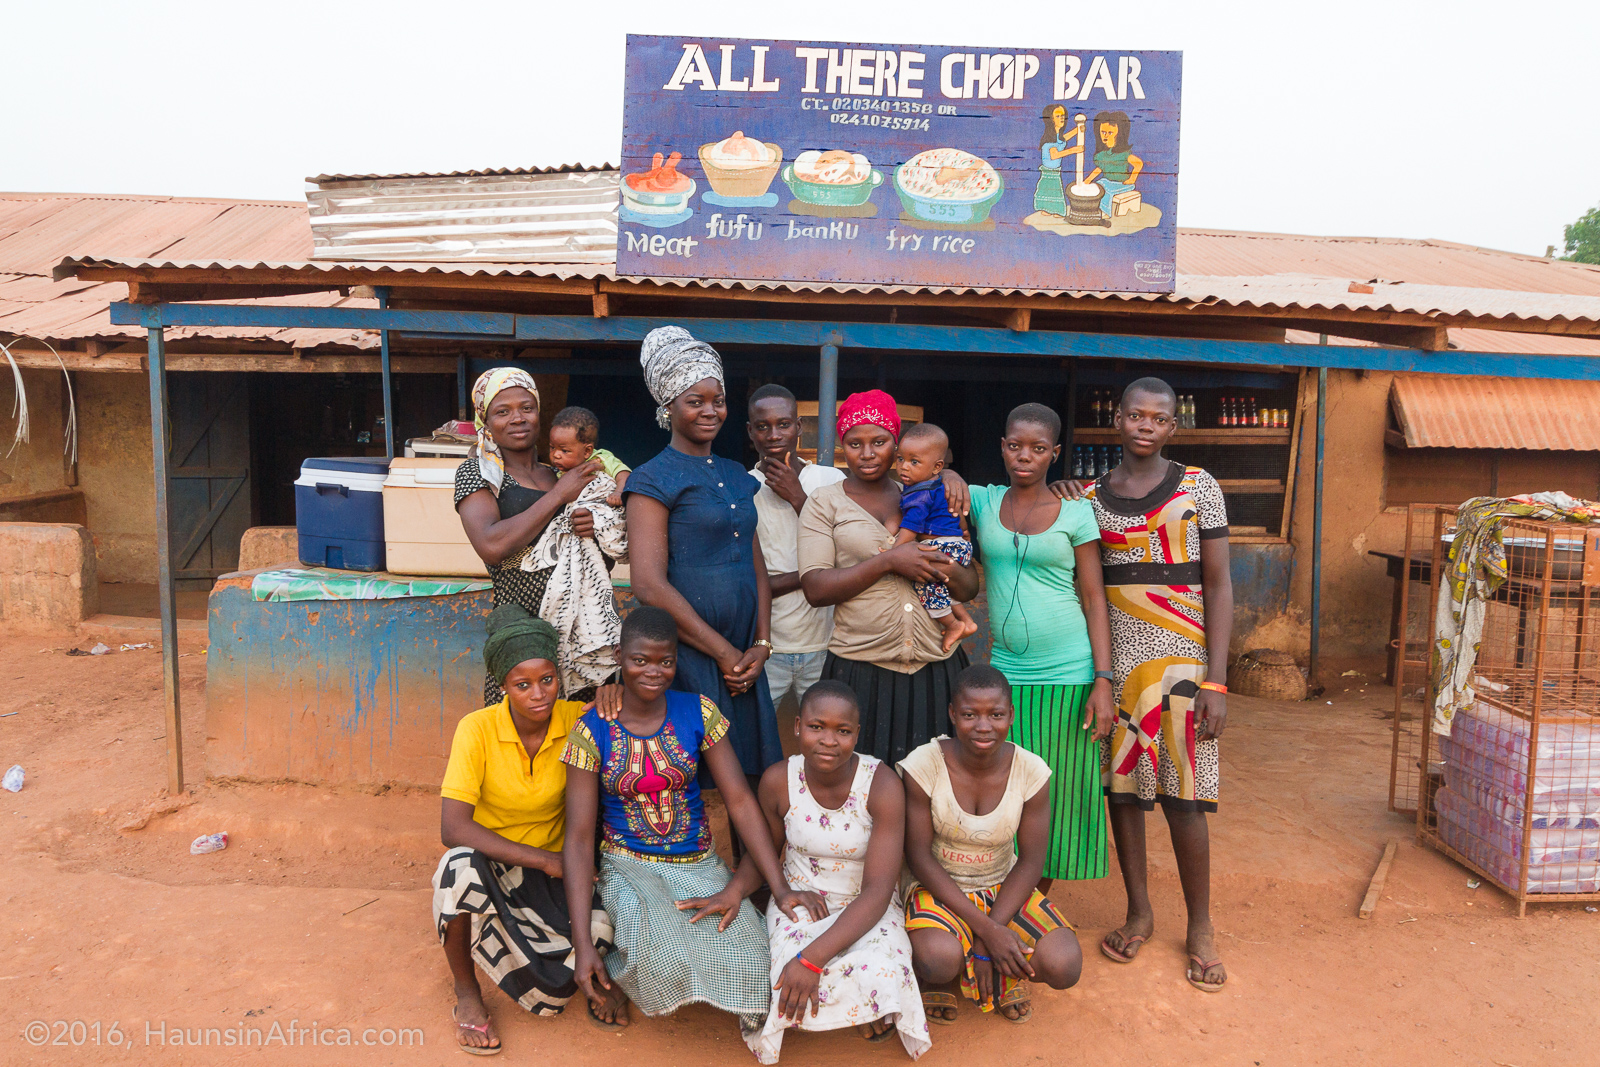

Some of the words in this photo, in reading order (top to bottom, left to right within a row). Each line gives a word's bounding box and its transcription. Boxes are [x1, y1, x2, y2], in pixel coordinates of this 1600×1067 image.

[662, 43, 780, 92] ALL
[795, 47, 926, 98] THERE
[940, 52, 1040, 100] CHOP
[1053, 54, 1146, 100] BAR
[831, 97, 933, 114] 0203401358
[937, 104, 957, 116] OR
[830, 113, 930, 132] 0241075914
[705, 213, 763, 241] fufu
[624, 231, 699, 258] Meat
[932, 234, 976, 254] rice
[942, 848, 994, 864] VERSACE
